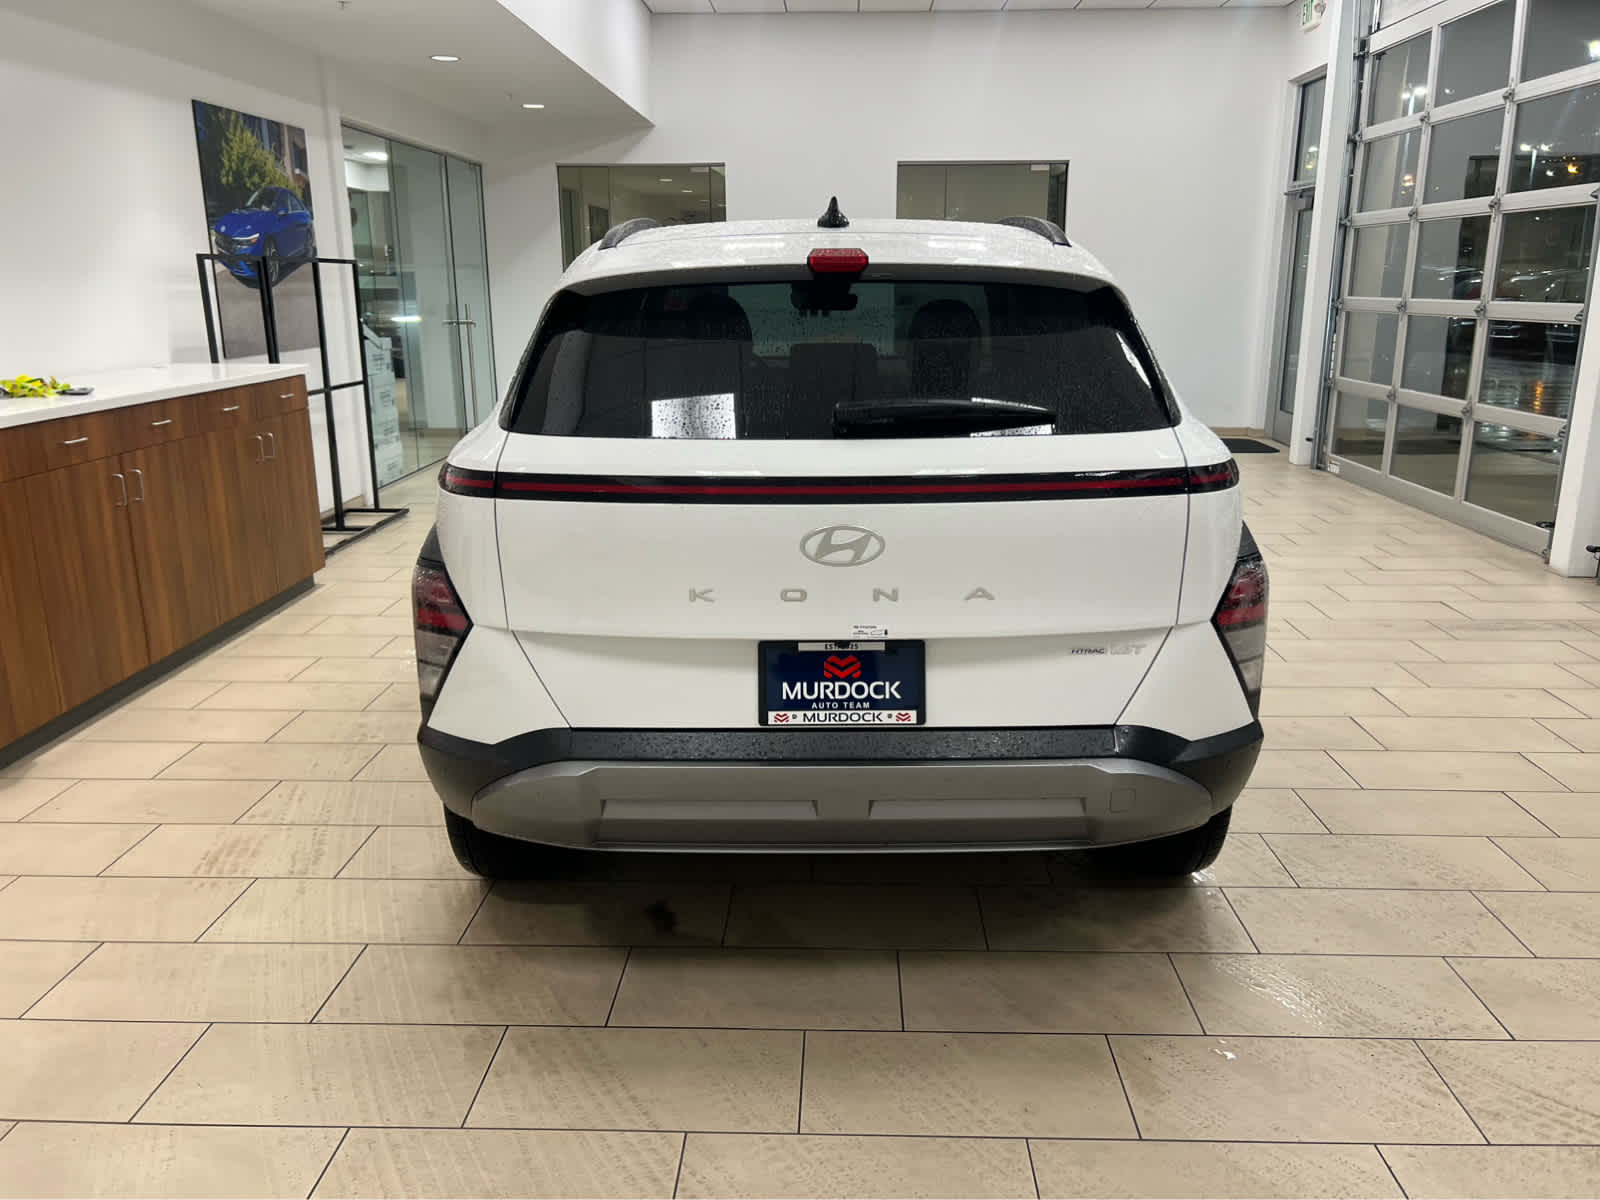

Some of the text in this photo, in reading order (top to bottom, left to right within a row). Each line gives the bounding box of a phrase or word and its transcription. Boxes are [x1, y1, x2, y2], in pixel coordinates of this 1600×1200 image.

[688, 587, 996, 602] KONA
[782, 681, 902, 700] MURDOCK
[811, 701, 870, 709] AUTO TEAM
[802, 712, 884, 723] MURDOCK
